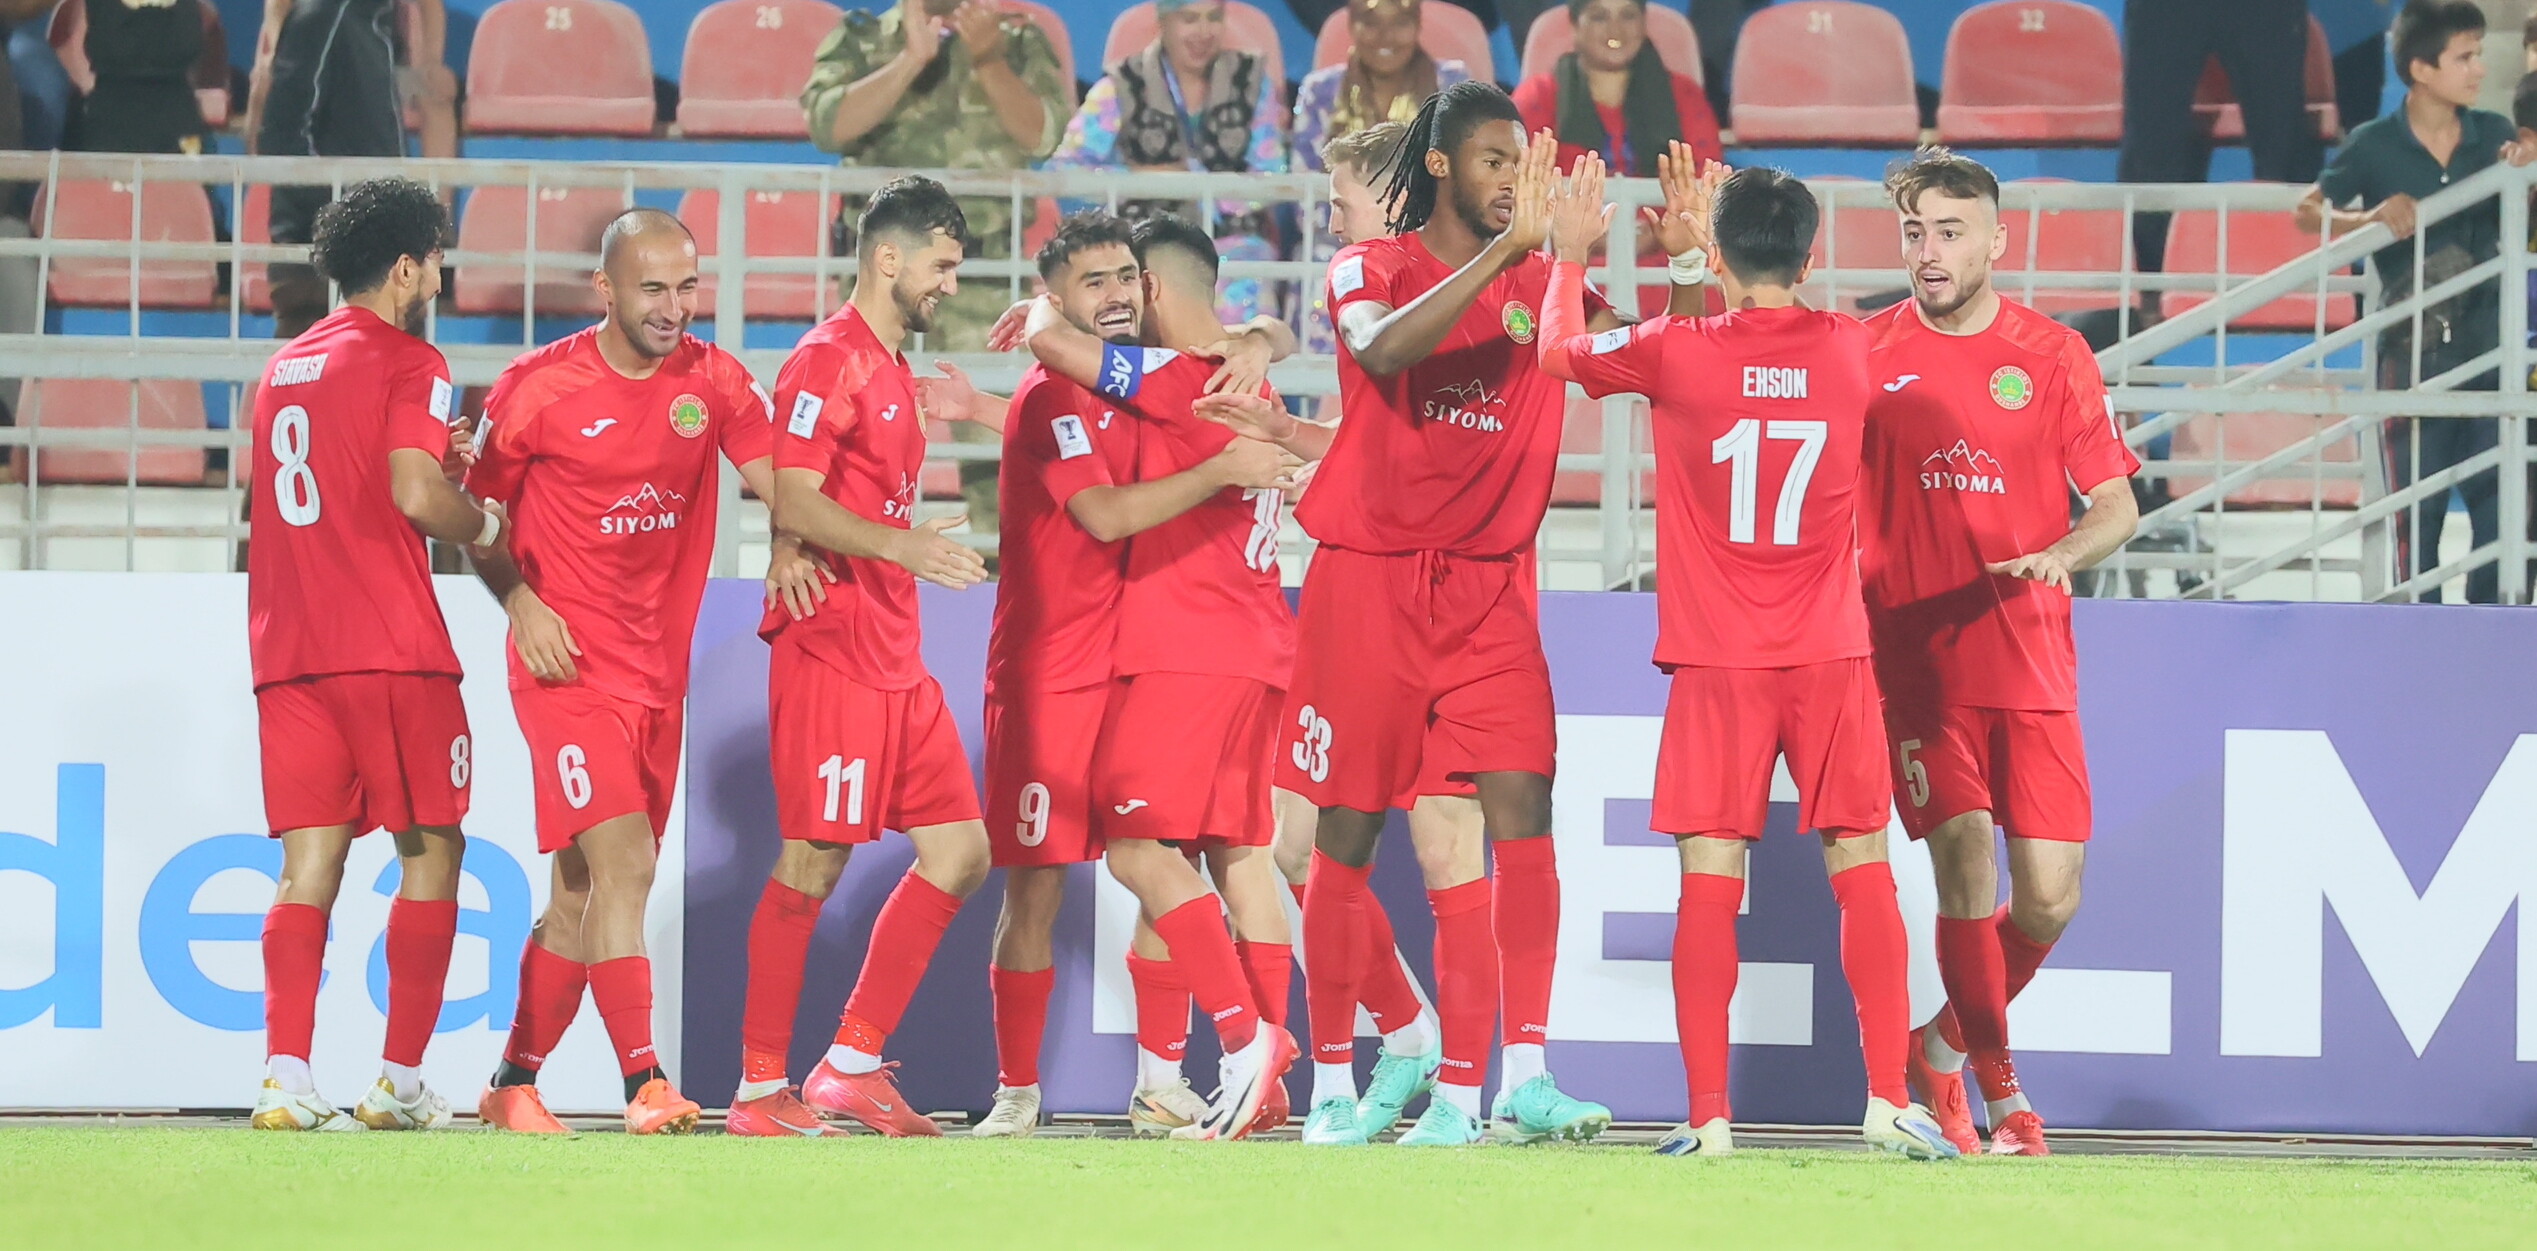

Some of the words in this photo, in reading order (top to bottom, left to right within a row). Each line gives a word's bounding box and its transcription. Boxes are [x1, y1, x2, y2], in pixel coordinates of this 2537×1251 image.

[270, 353, 330, 388] SIAVASH
[1104, 349, 1133, 398] AFC
[1742, 366, 1808, 399] EHSON
[271, 405, 321, 527] 8
[1711, 418, 1828, 546] 17
[1919, 471, 2006, 495] SIYOMA
[600, 511, 683, 535] SIYOM
[450, 734, 469, 789] 8
[1292, 704, 1333, 783] 33
[1900, 738, 1930, 808] 5
[557, 744, 593, 810] 6
[817, 754, 866, 825] 11
[1016, 782, 1051, 847] 9
